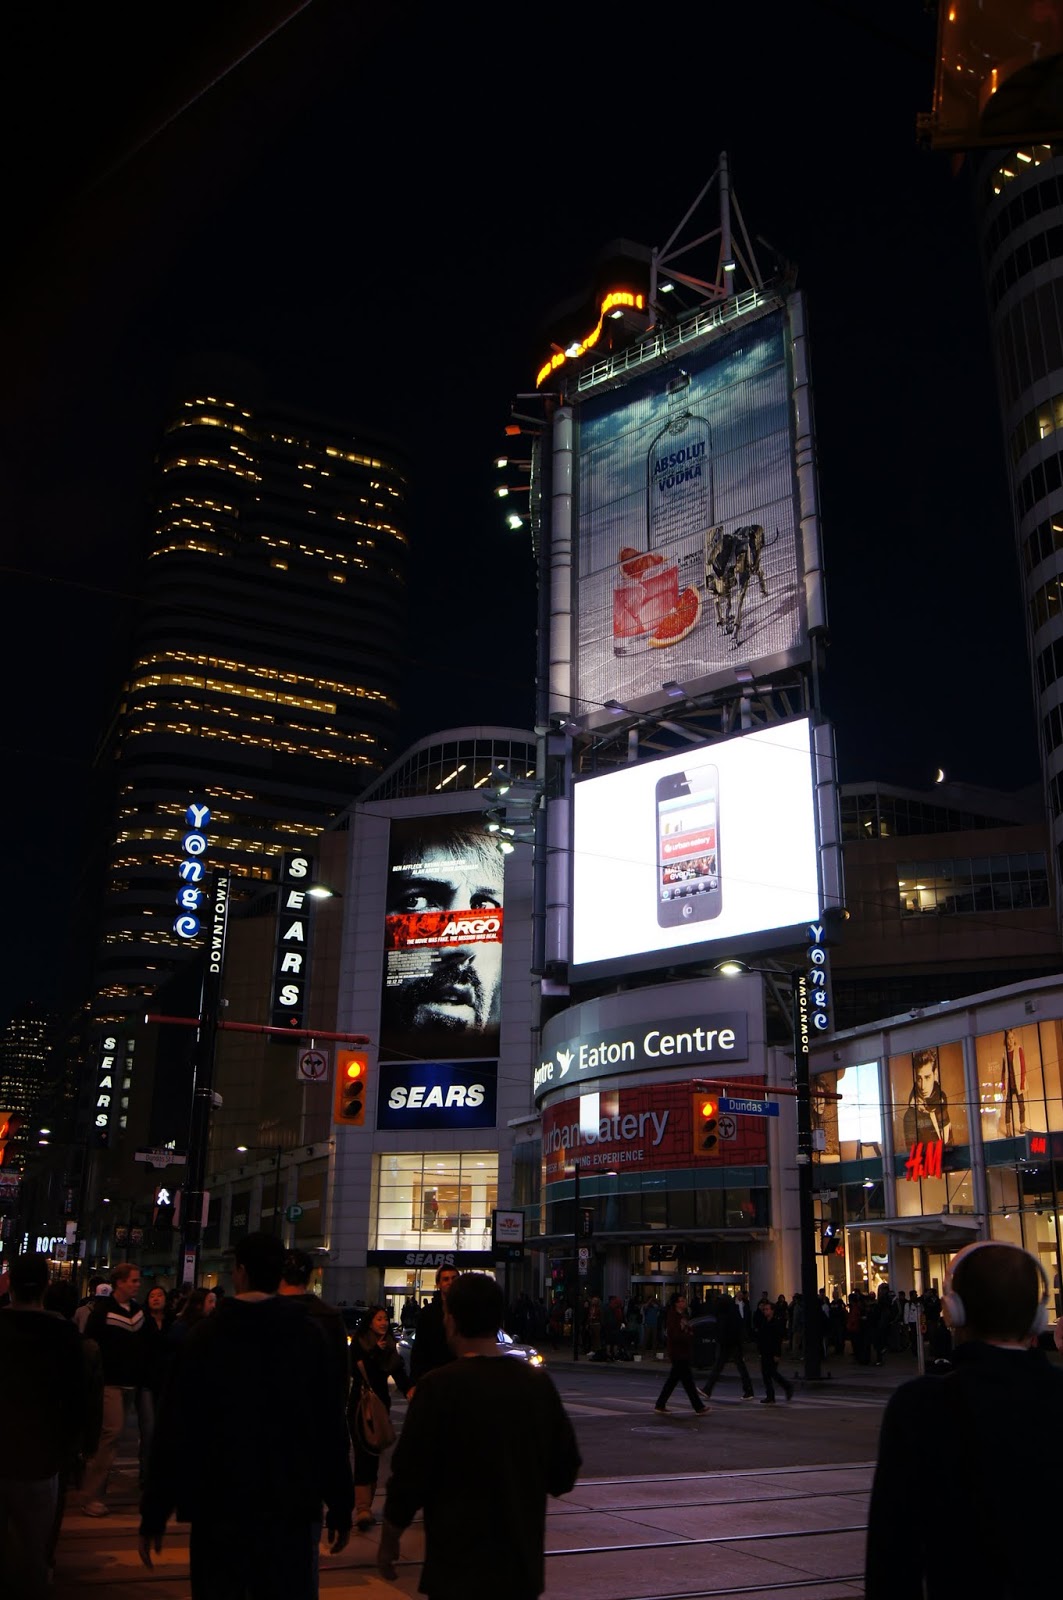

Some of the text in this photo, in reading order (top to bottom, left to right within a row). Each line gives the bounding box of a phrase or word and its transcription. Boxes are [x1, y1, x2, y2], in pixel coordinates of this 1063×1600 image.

[654, 441, 706, 475] ABSOLUT
[659, 464, 702, 492] VODKA
[174, 803, 209, 939] Yonge
[210, 877, 227, 974] DOWNTOWN
[279, 857, 309, 1006] SEARS
[441, 919, 501, 937] ARGO
[810, 924, 828, 1030] Yonge
[799, 977, 809, 1053] DOWNTOWN
[579, 1027, 735, 1070] Eaton Centre
[95, 1037, 117, 1127] SEARS
[388, 1084, 486, 1109] SEARS
[729, 1100, 762, 1112] Dundas
[544, 1122, 581, 1155] urban
[593, 1150, 644, 1164] EXPERIENCE
[905, 1139, 944, 1182] H&M
[290, 1206, 302, 1219] P
[405, 1253, 456, 1266] SEARS
